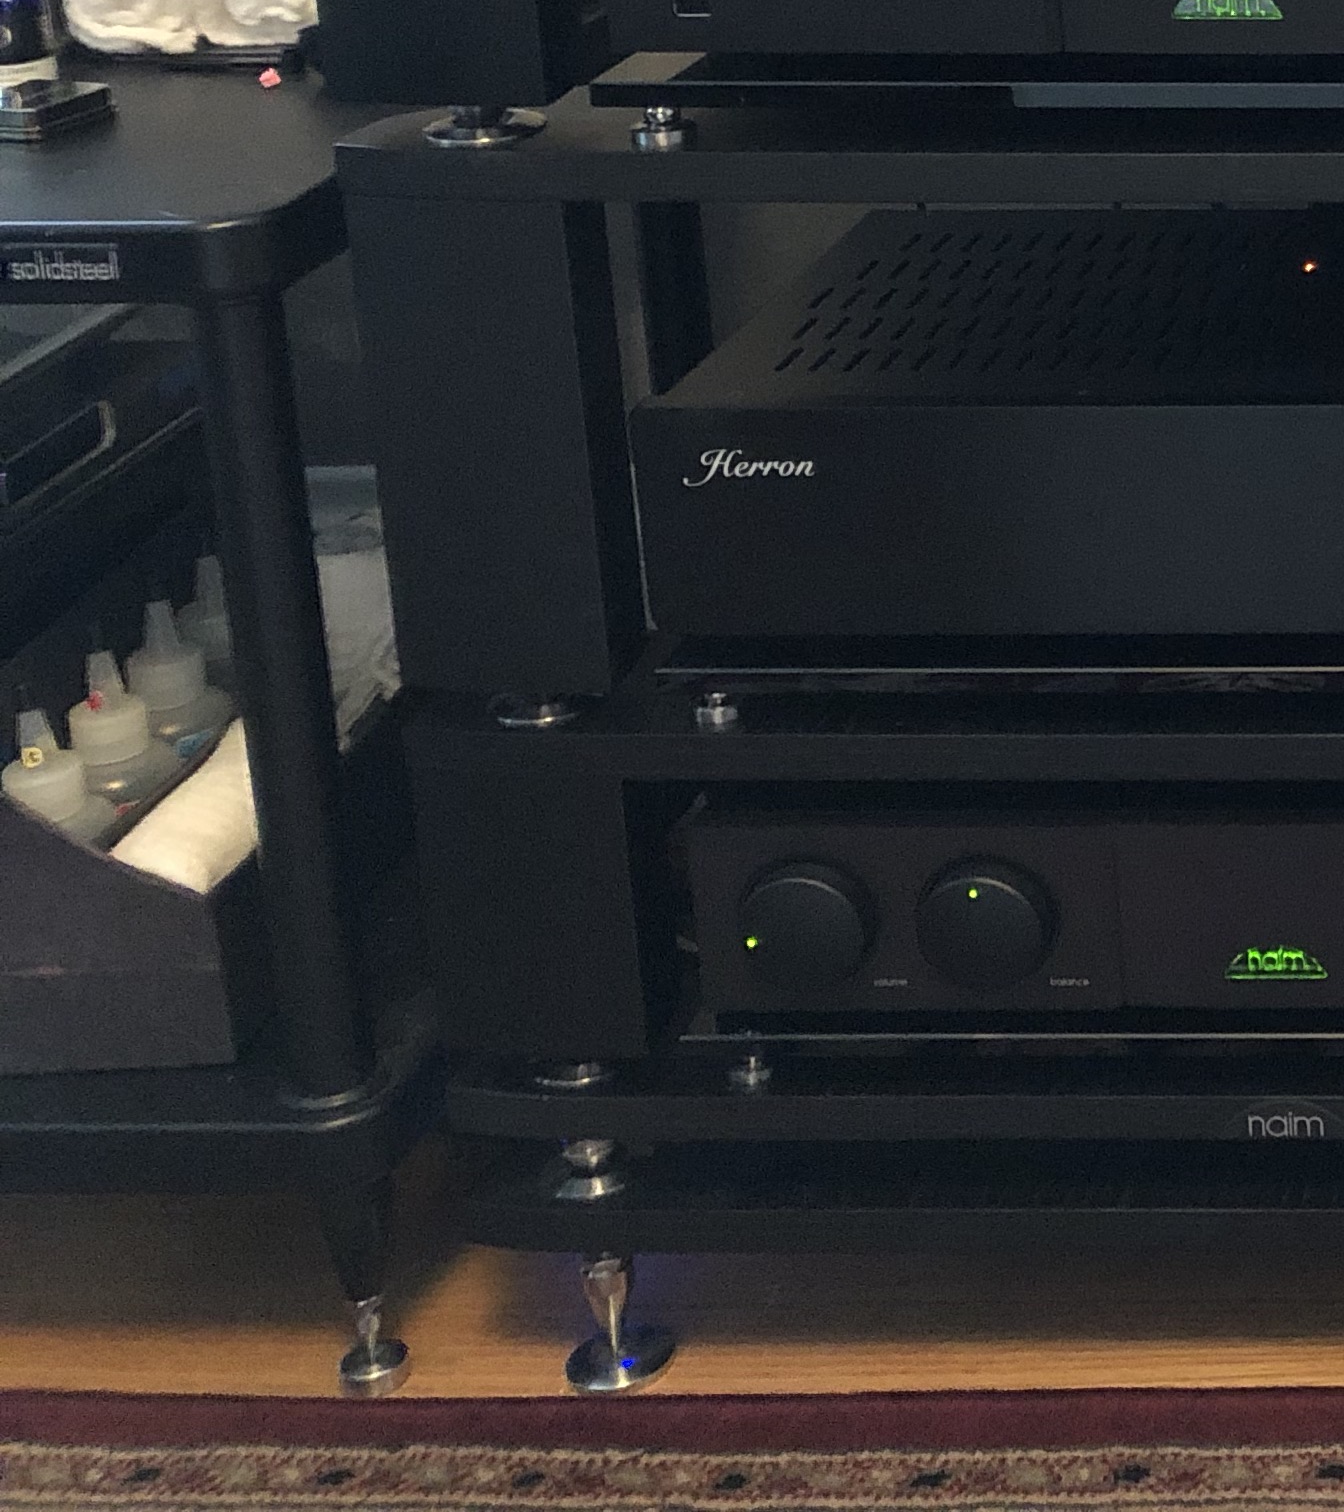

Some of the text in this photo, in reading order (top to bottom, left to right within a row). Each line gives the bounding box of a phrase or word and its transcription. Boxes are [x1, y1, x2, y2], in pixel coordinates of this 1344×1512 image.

[9, 250, 119, 281] solidsteel
[682, 448, 816, 487] Herron
[1247, 946, 1305, 972] naim
[1247, 1111, 1326, 1138] naim
